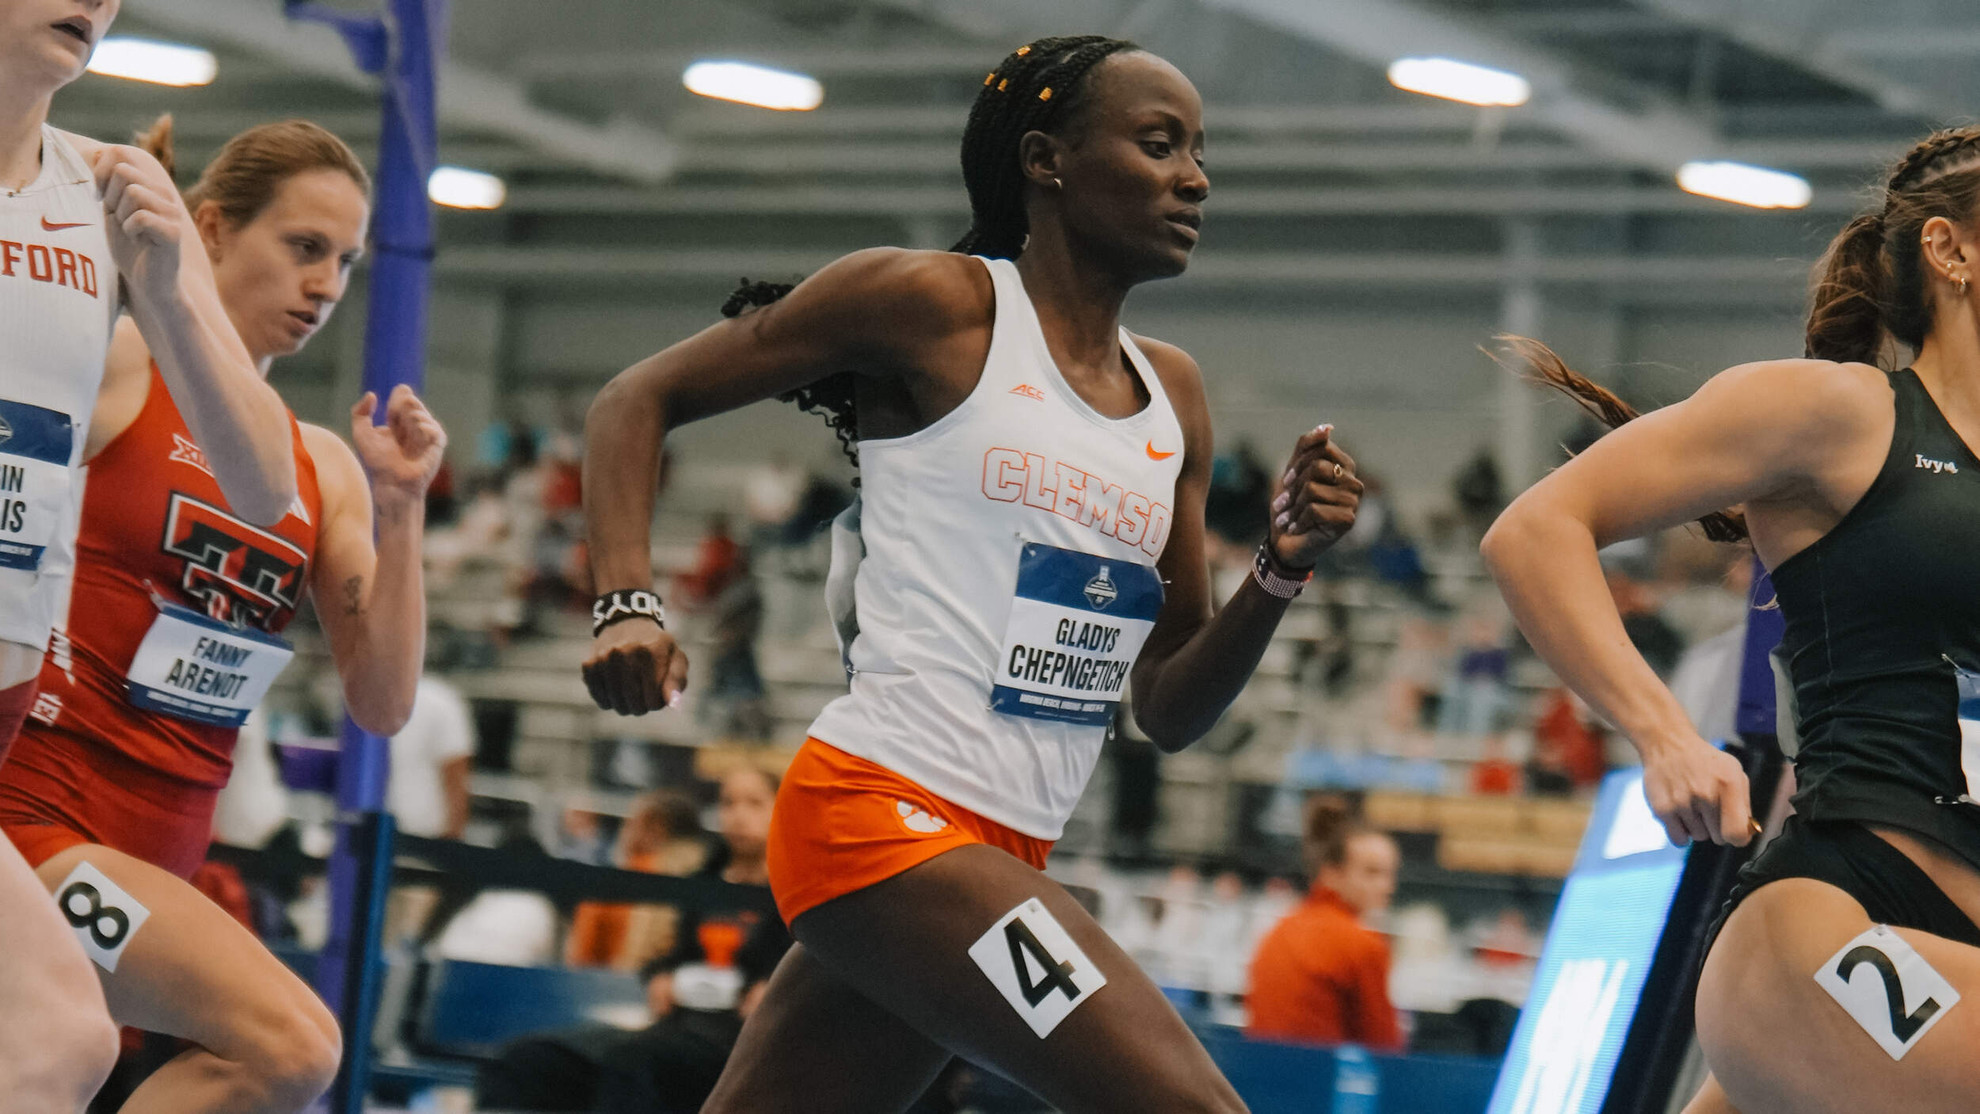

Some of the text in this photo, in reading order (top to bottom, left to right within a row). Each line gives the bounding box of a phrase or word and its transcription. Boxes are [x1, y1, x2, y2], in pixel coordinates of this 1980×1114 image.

[0, 240, 98, 298] FORD
[1009, 384, 1045, 401] ACC
[1915, 454, 1944, 474] Ivy
[192, 635, 253, 668] FANNY
[1056, 618, 1121, 653] GLADYS
[165, 658, 249, 700] ARENDT
[1008, 644, 1130, 692] CHEPNGETICH
[58, 881, 130, 950] 8
[1004, 916, 1082, 1009] 4
[1836, 945, 1942, 1044] 2
